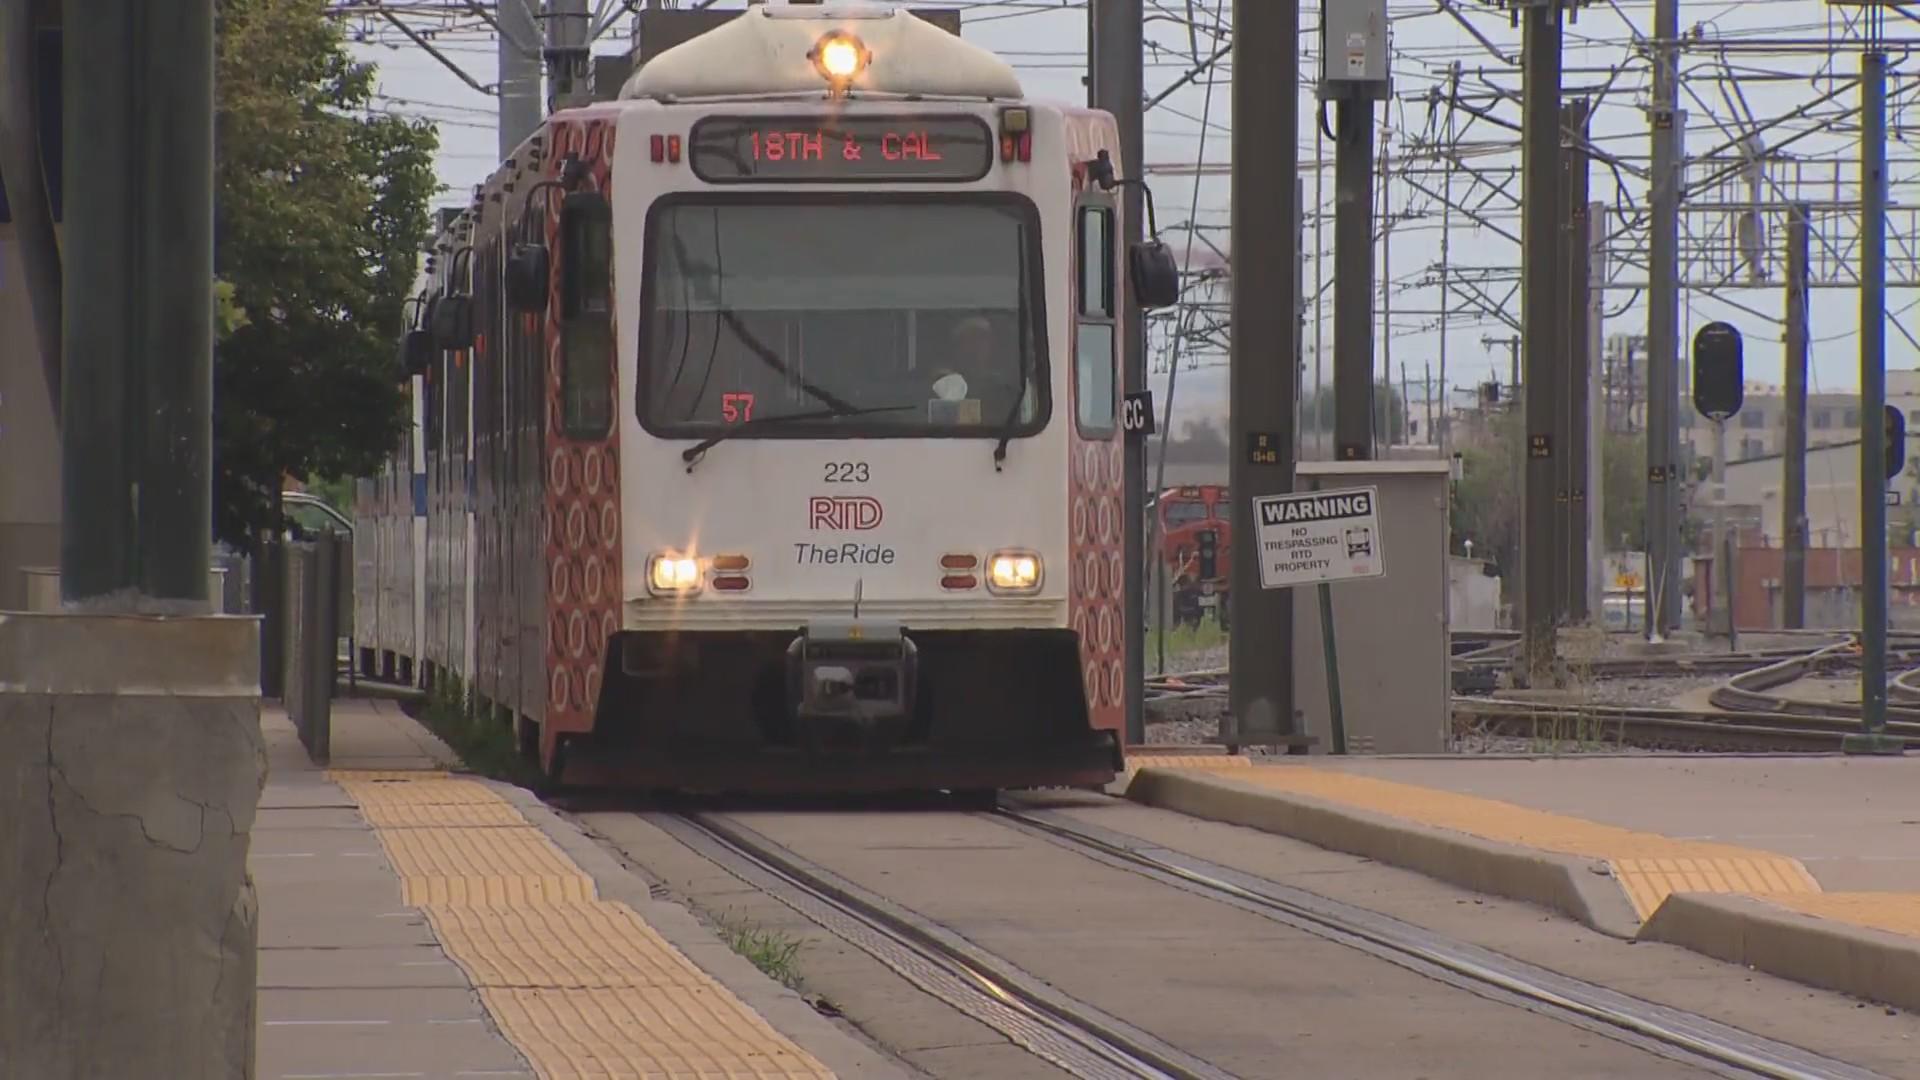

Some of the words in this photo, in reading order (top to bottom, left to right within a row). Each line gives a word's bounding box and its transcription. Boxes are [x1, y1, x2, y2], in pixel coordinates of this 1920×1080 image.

[752, 131, 823, 161] 18TH
[843, 132, 862, 161] &
[882, 131, 942, 161] CAL
[722, 392, 754, 422] 57
[824, 462, 870, 482] 223
[809, 496, 883, 530] RTD
[1264, 496, 1368, 522] WARNING
[1291, 528, 1308, 537] NO
[794, 543, 895, 564] TheRide
[1264, 536, 1338, 551] TRESPASSING
[1290, 550, 1313, 560] RTD
[1274, 560, 1331, 573] PROPERTY
